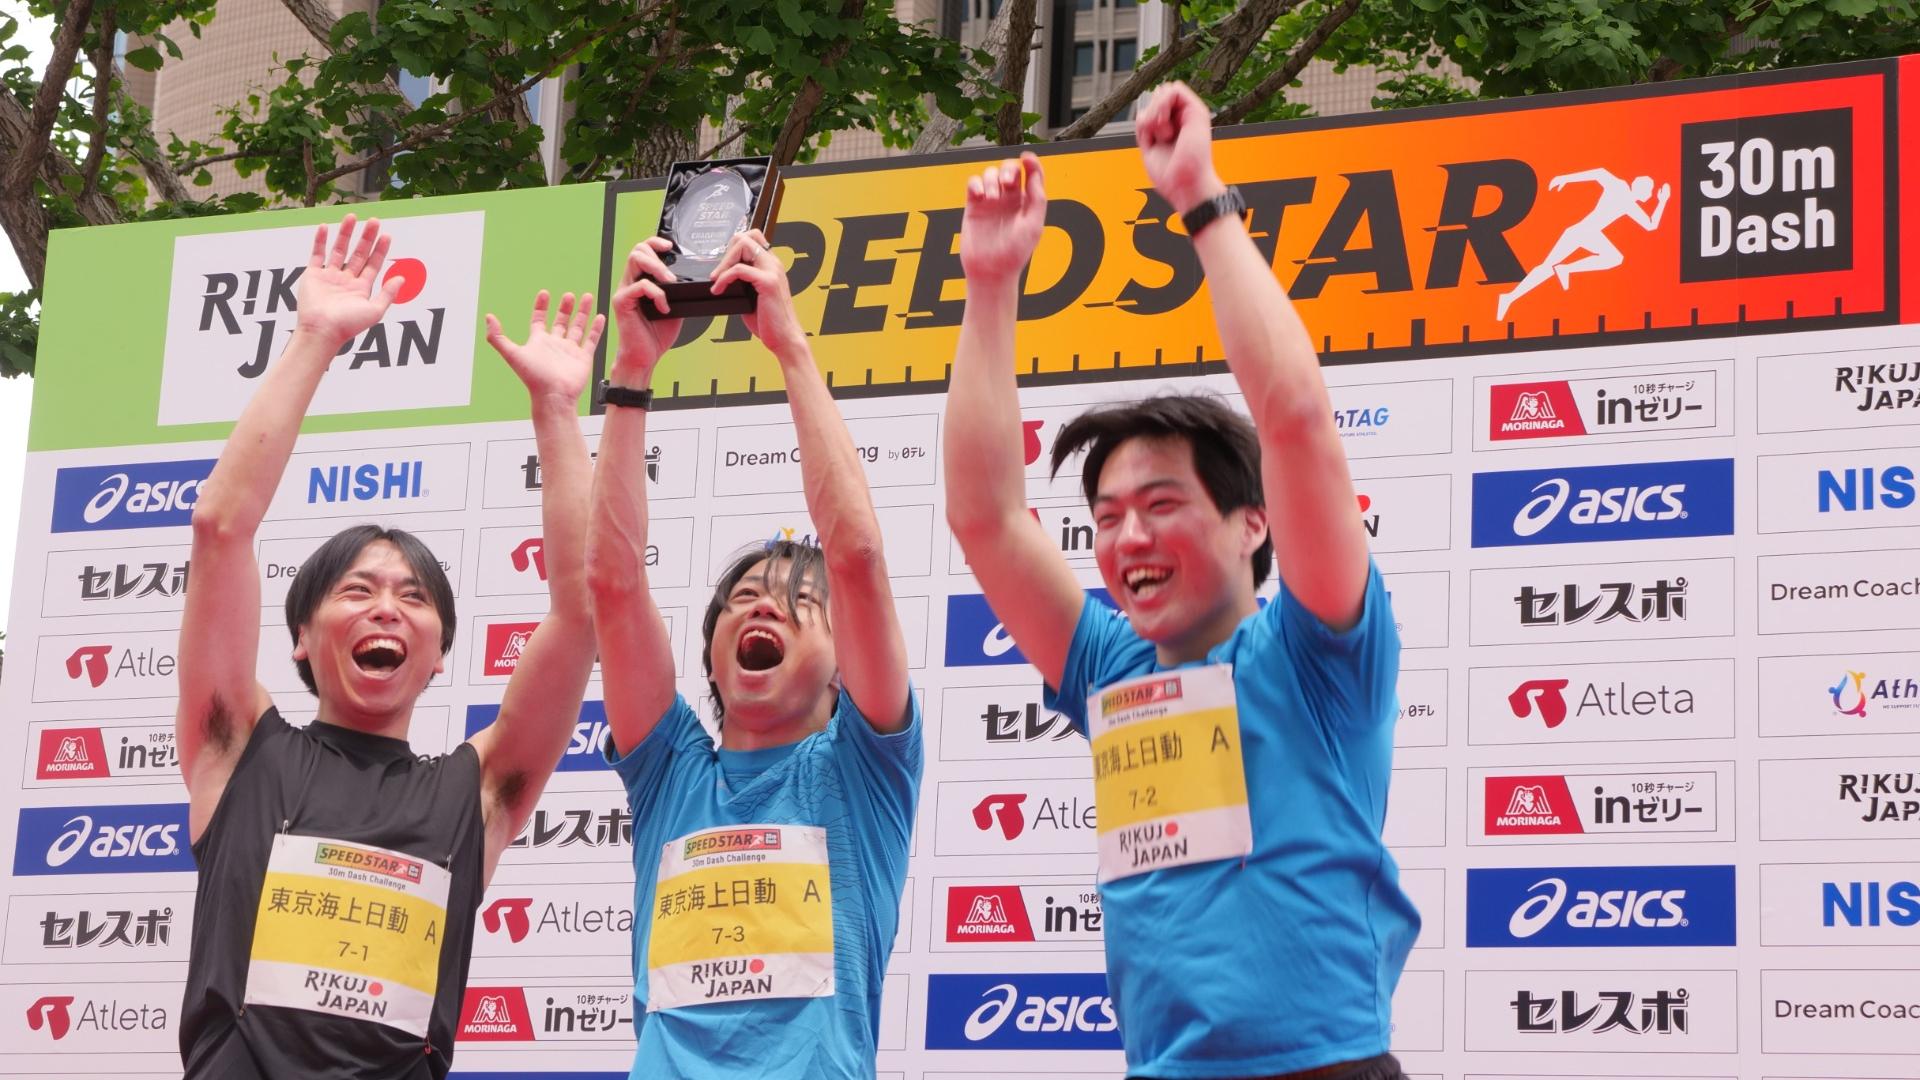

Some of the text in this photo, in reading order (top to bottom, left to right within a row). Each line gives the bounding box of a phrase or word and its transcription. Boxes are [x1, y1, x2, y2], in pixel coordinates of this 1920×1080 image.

[1700, 136, 1836, 199] 30m
[1700, 197, 1836, 258] Dash
[237, 307, 446, 379] JAN
[1633, 380, 1696, 395] 10秒チャージ
[1334, 407, 1390, 429] hTAG
[1596, 388, 1702, 426] inゼリー
[1501, 419, 1565, 432] MORINAGA
[725, 449, 787, 467] Dream
[307, 460, 423, 504] NISHI
[1818, 465, 1916, 513] NIS
[1568, 483, 1686, 525] asics
[266, 563, 301, 579] Dre
[1513, 576, 1689, 628] セレスポ
[1771, 583, 1849, 601] Dream
[114, 647, 176, 678] Atle
[1576, 681, 1694, 717] Atleta
[980, 702, 1089, 743] セレ
[1210, 724, 1231, 753] A
[46, 761, 94, 772] MORINAGA
[118, 736, 180, 769] inゼリ
[1129, 785, 1158, 810] 7-2
[1631, 781, 1695, 794] 10秒チャージ
[1032, 797, 1097, 830] Atle
[1496, 815, 1562, 827] MORINAGA
[1594, 785, 1703, 824] inゼリー
[89, 823, 180, 858] asics
[508, 807, 633, 849] レスポ
[1132, 837, 1188, 867] JAPAN
[657, 877, 822, 920] 東京海上日動 A
[1566, 889, 1687, 928] asics
[1822, 881, 1920, 927] NIS
[39, 906, 173, 948] セレスポ
[267, 886, 437, 945] 東京海上日動 A
[536, 901, 633, 934] Atleta
[957, 924, 1015, 934] MORINAGA
[338, 940, 369, 962] 7-1
[711, 925, 746, 945] 7-3
[704, 974, 773, 998] JAPAN
[76, 999, 167, 1031] Atleta
[317, 989, 388, 1018] JAPAN
[1510, 987, 1689, 1035] セレスポ
[1774, 1000, 1855, 1018] Dream
[464, 1023, 517, 1033] MORINAGA
